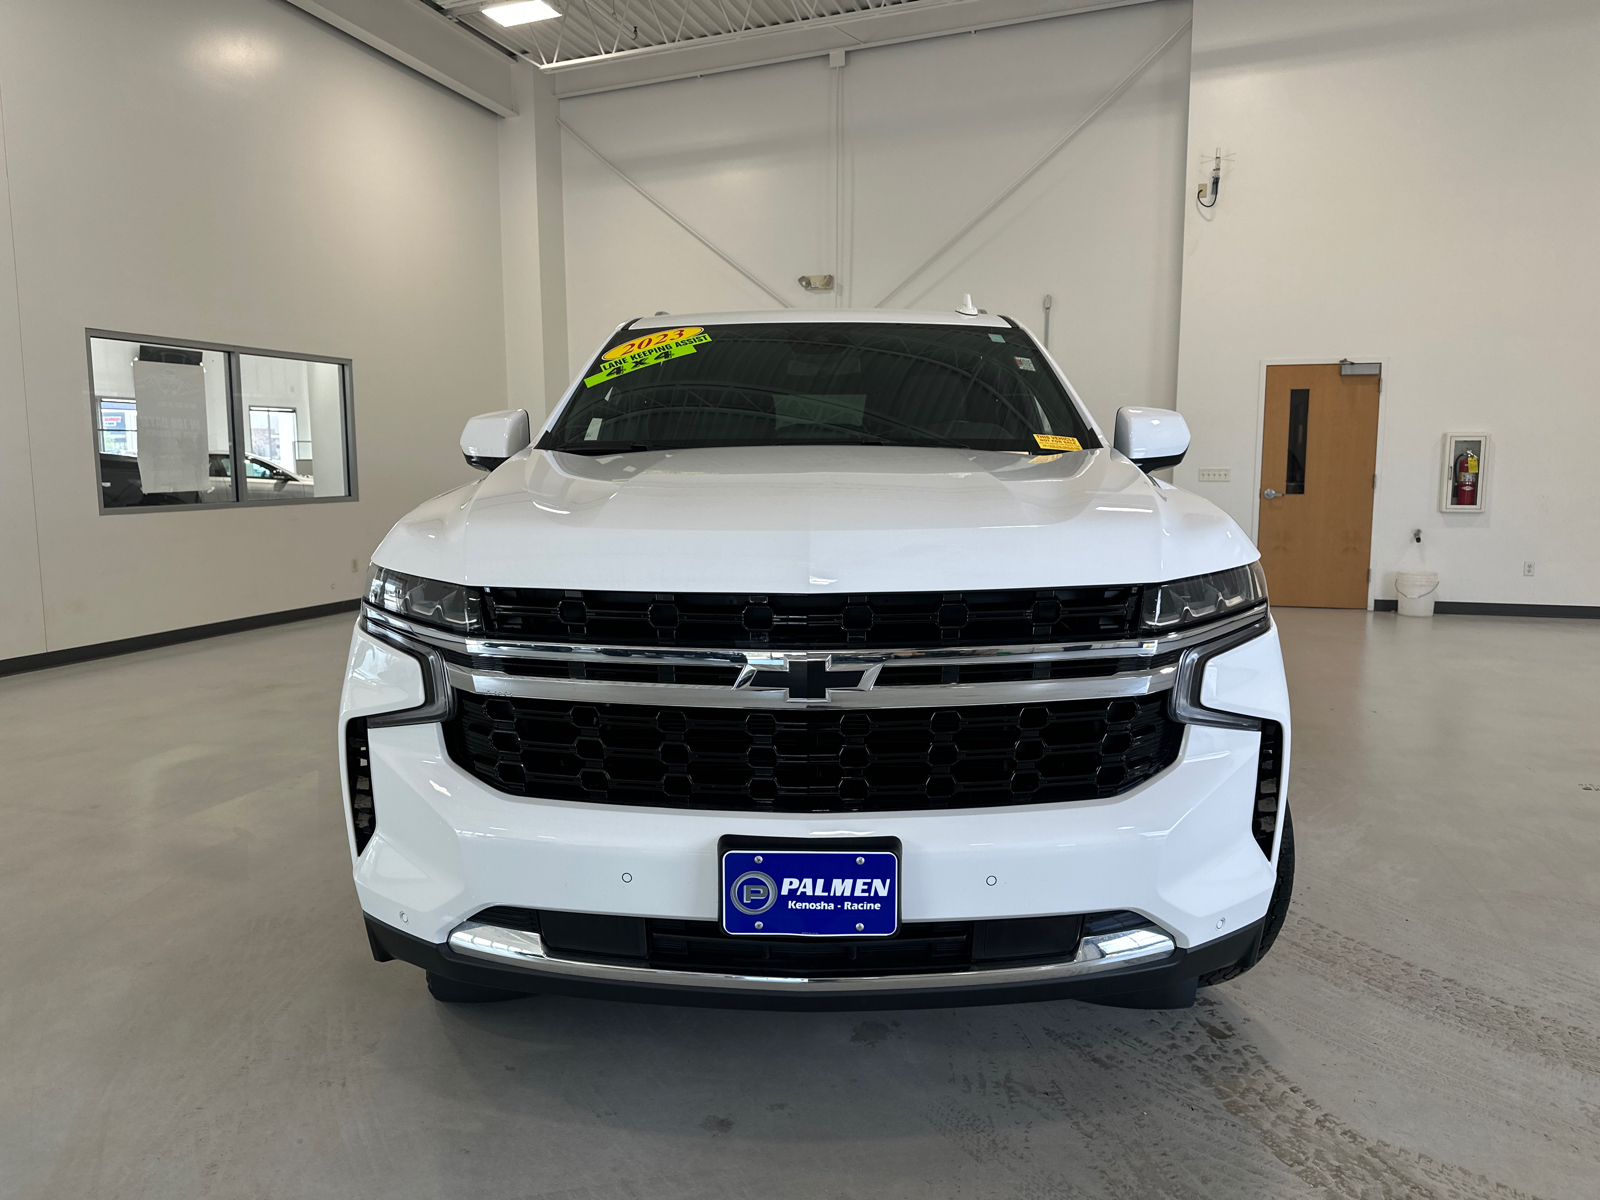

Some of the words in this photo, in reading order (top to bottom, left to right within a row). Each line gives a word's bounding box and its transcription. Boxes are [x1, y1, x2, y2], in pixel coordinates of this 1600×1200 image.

[621, 329, 685, 356] 2023
[602, 357, 629, 372] LANE
[630, 344, 673, 363] KEEPING
[675, 335, 709, 348] ASSIST
[743, 884, 768, 904] P
[780, 878, 891, 897] PALMEN
[788, 900, 835, 910] Kenosha
[844, 901, 881, 910] Racine
